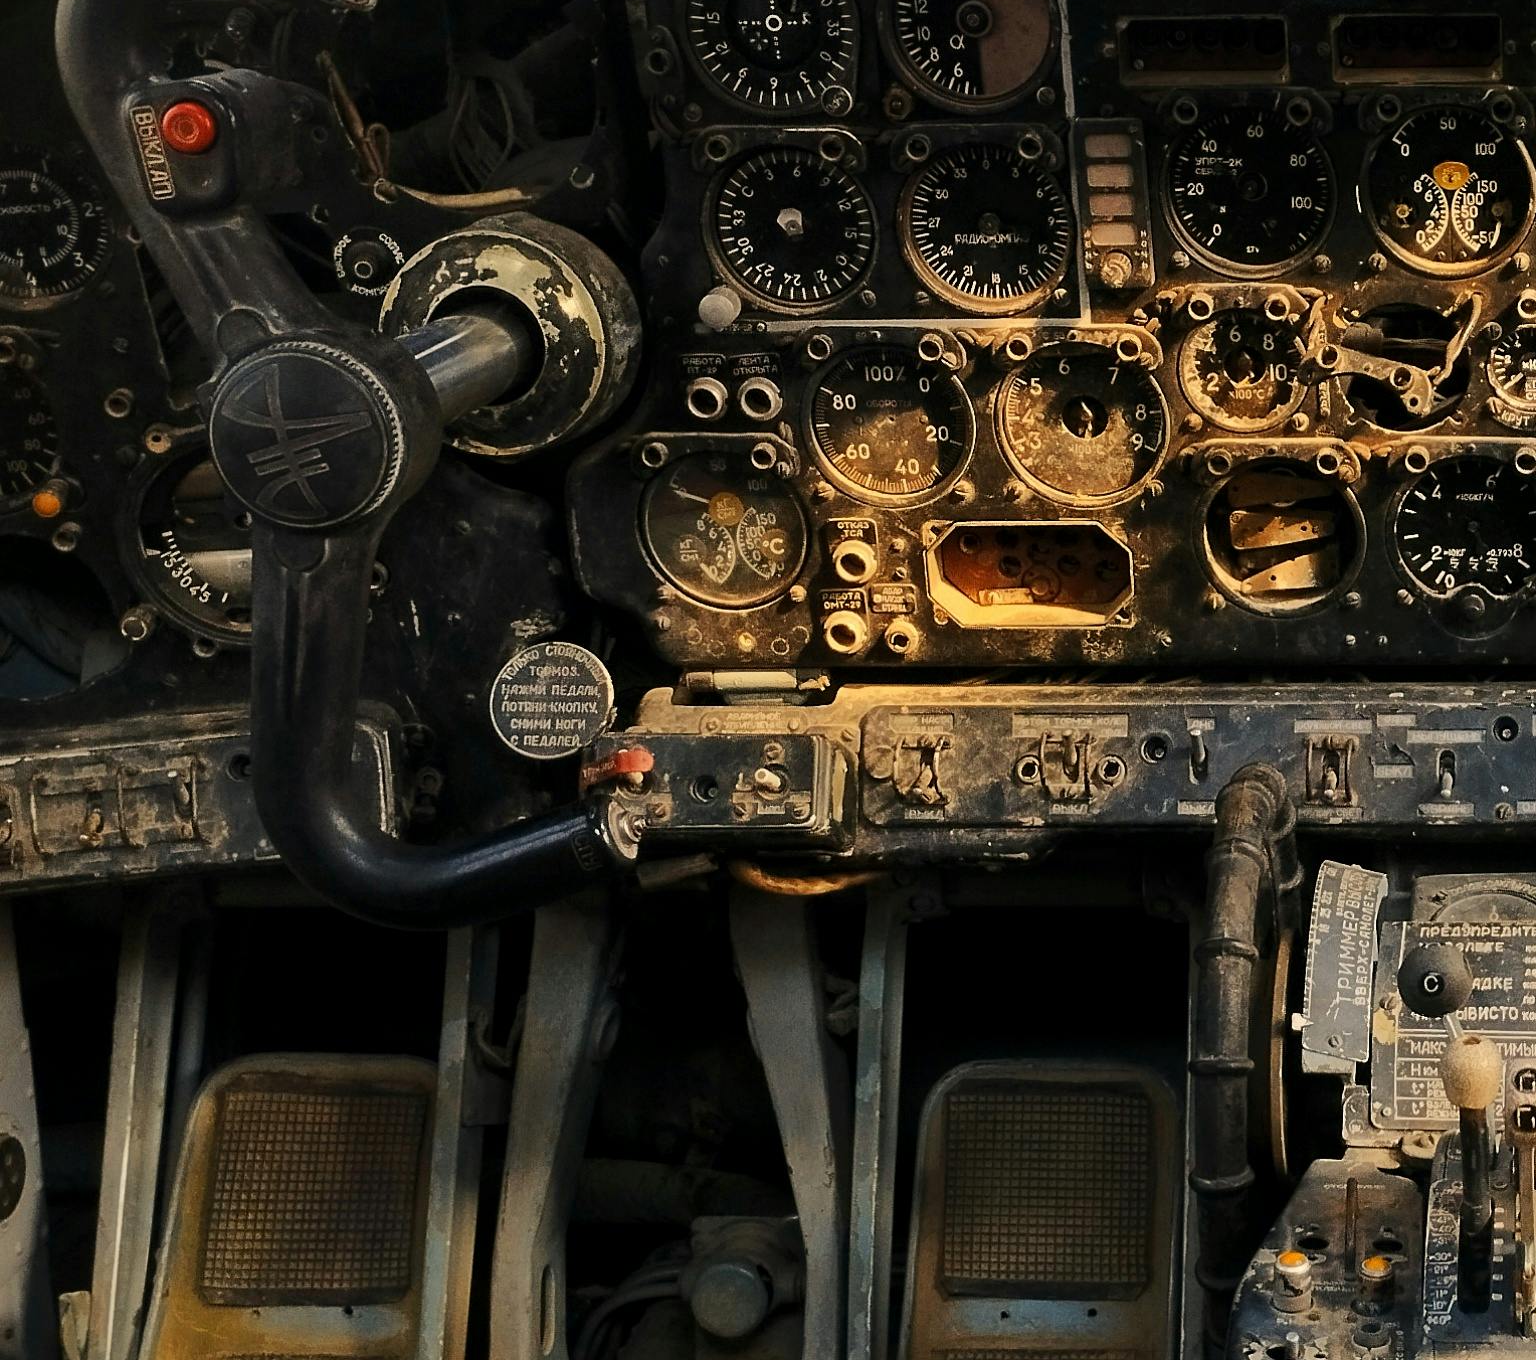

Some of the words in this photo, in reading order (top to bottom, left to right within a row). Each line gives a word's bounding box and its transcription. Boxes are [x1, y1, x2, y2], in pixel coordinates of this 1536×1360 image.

[826, 19, 840, 37] 33
[1247, 125, 1263, 138] 60
[1202, 140, 1217, 152] 40
[1475, 143, 1496, 155] 100
[1187, 183, 1205, 195] 20
[1477, 180, 1498, 193] 150
[83, 202, 95, 216] 2
[1291, 196, 1312, 209] 100
[928, 217, 941, 228] 27
[991, 271, 1001, 284] 18
[1059, 358, 1070, 375] 6
[1269, 363, 1287, 382] 10
[864, 365, 903, 382] 100%
[1135, 404, 1146, 421] 8
[1501, 410, 1530, 426] КРУТ
[926, 426, 949, 442] 20
[894, 459, 919, 475] 40
[837, 521, 869, 530] ОТКАЗ
[1431, 545, 1443, 561] 2
[501, 650, 540, 681] ТОЛЬКО
[501, 684, 546, 696] НАЖМИ
[501, 701, 547, 713] ПОТЯНИ
[510, 718, 551, 730] СНИМИ
[555, 718, 586, 730] НОГИ
[510, 735, 518, 746] С
